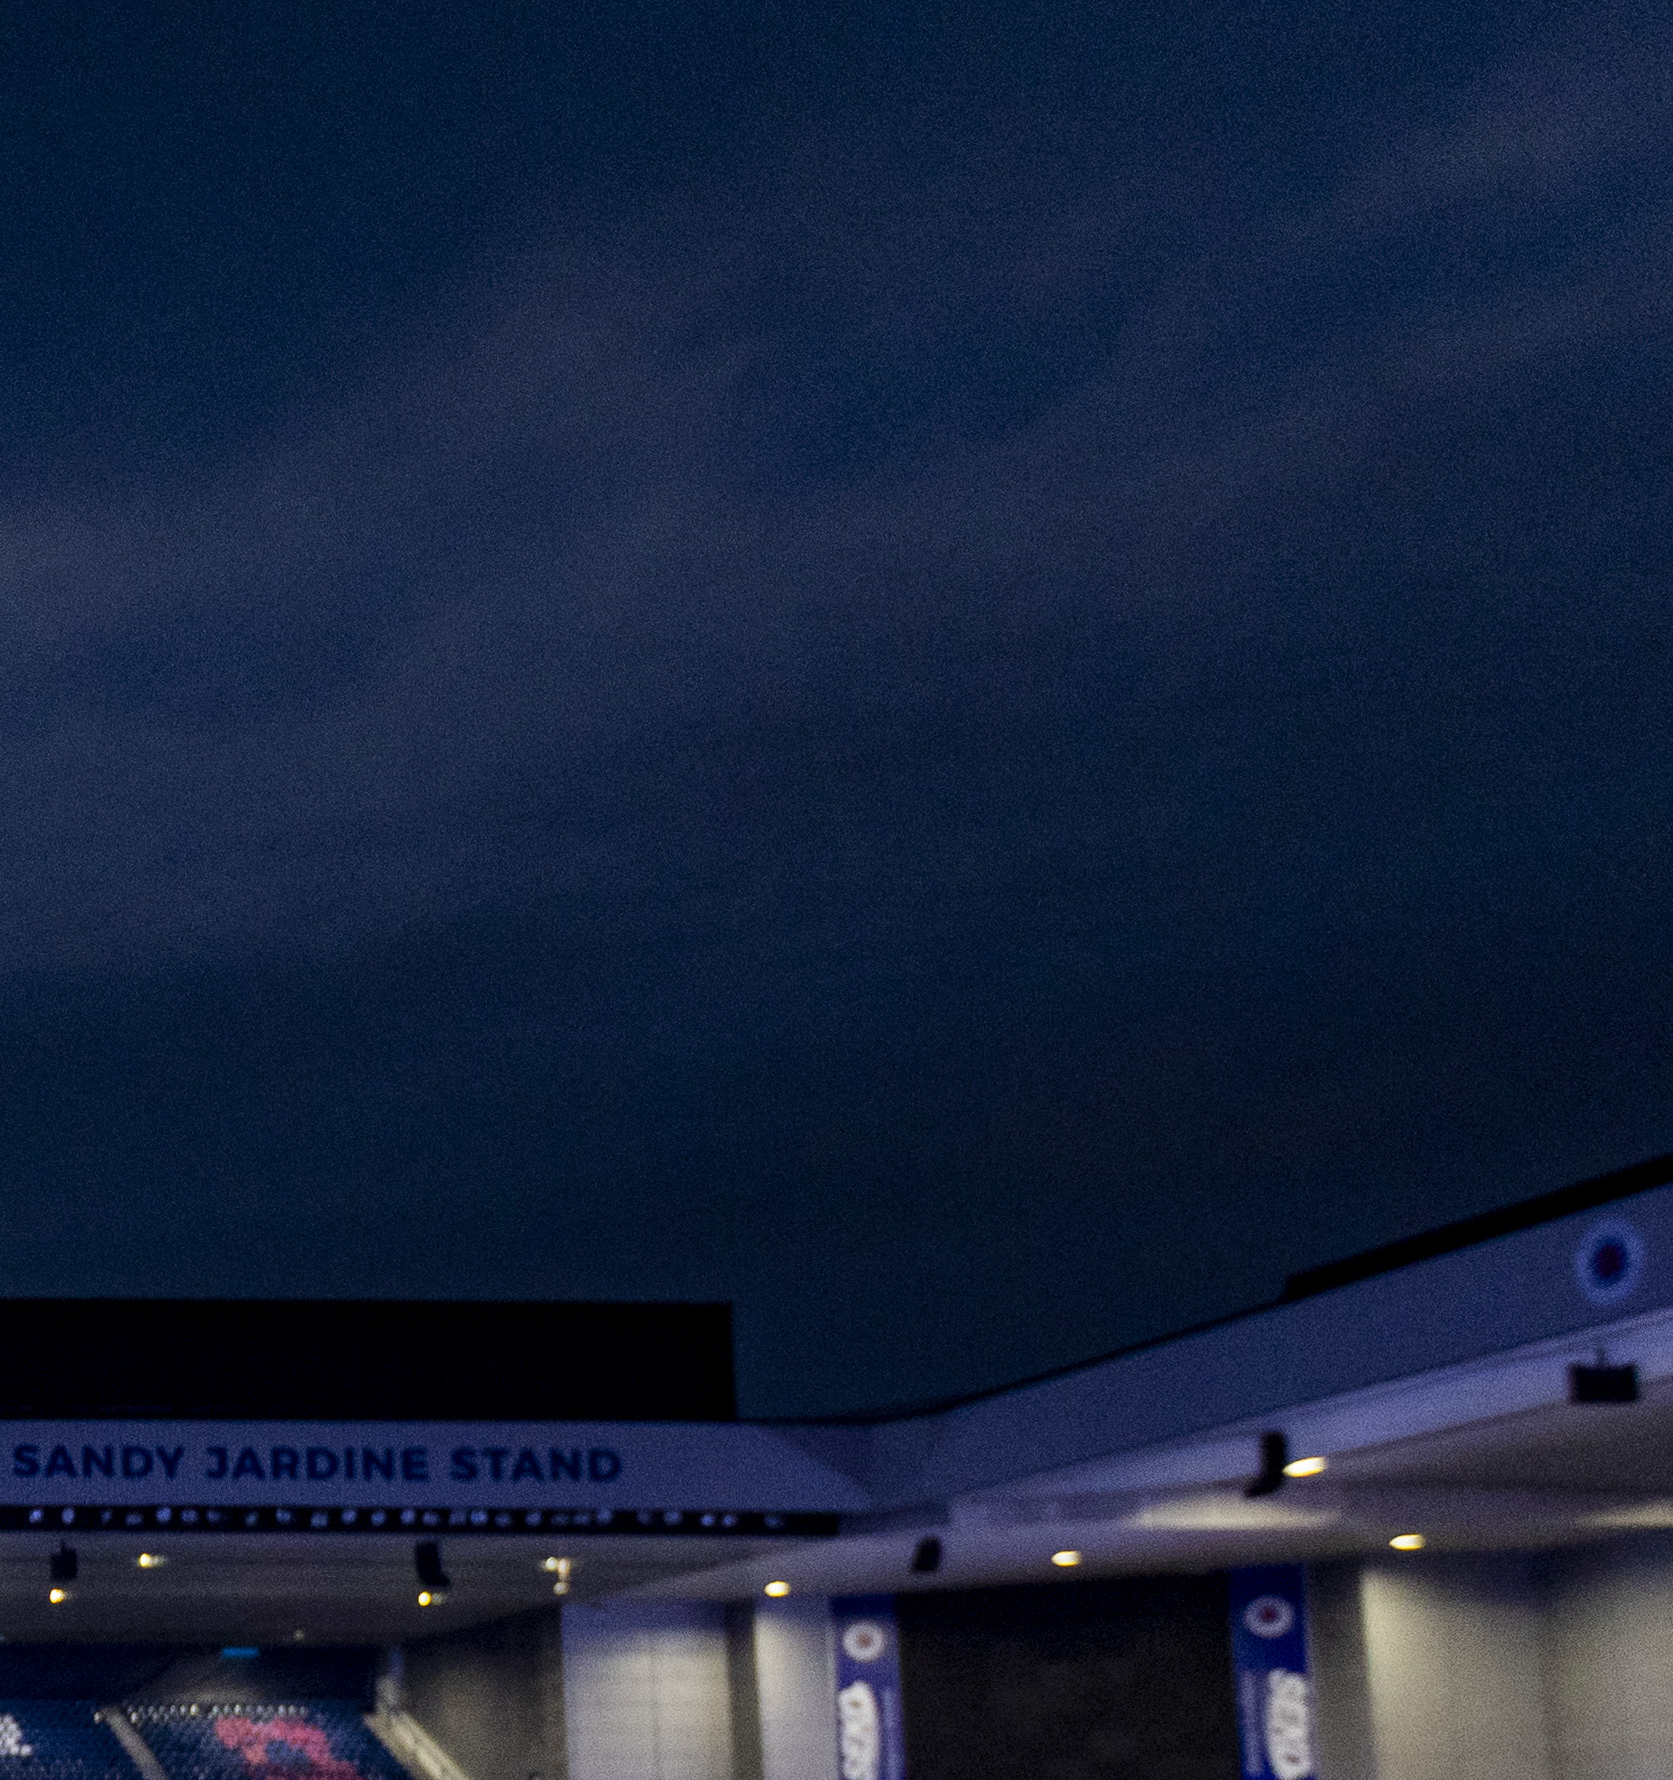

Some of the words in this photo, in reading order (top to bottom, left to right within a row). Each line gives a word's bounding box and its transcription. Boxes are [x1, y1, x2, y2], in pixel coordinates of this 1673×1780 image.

[12, 1444, 186, 1479] SANDY
[205, 1445, 431, 1481] JARDINE
[449, 1446, 623, 1483] STAND
